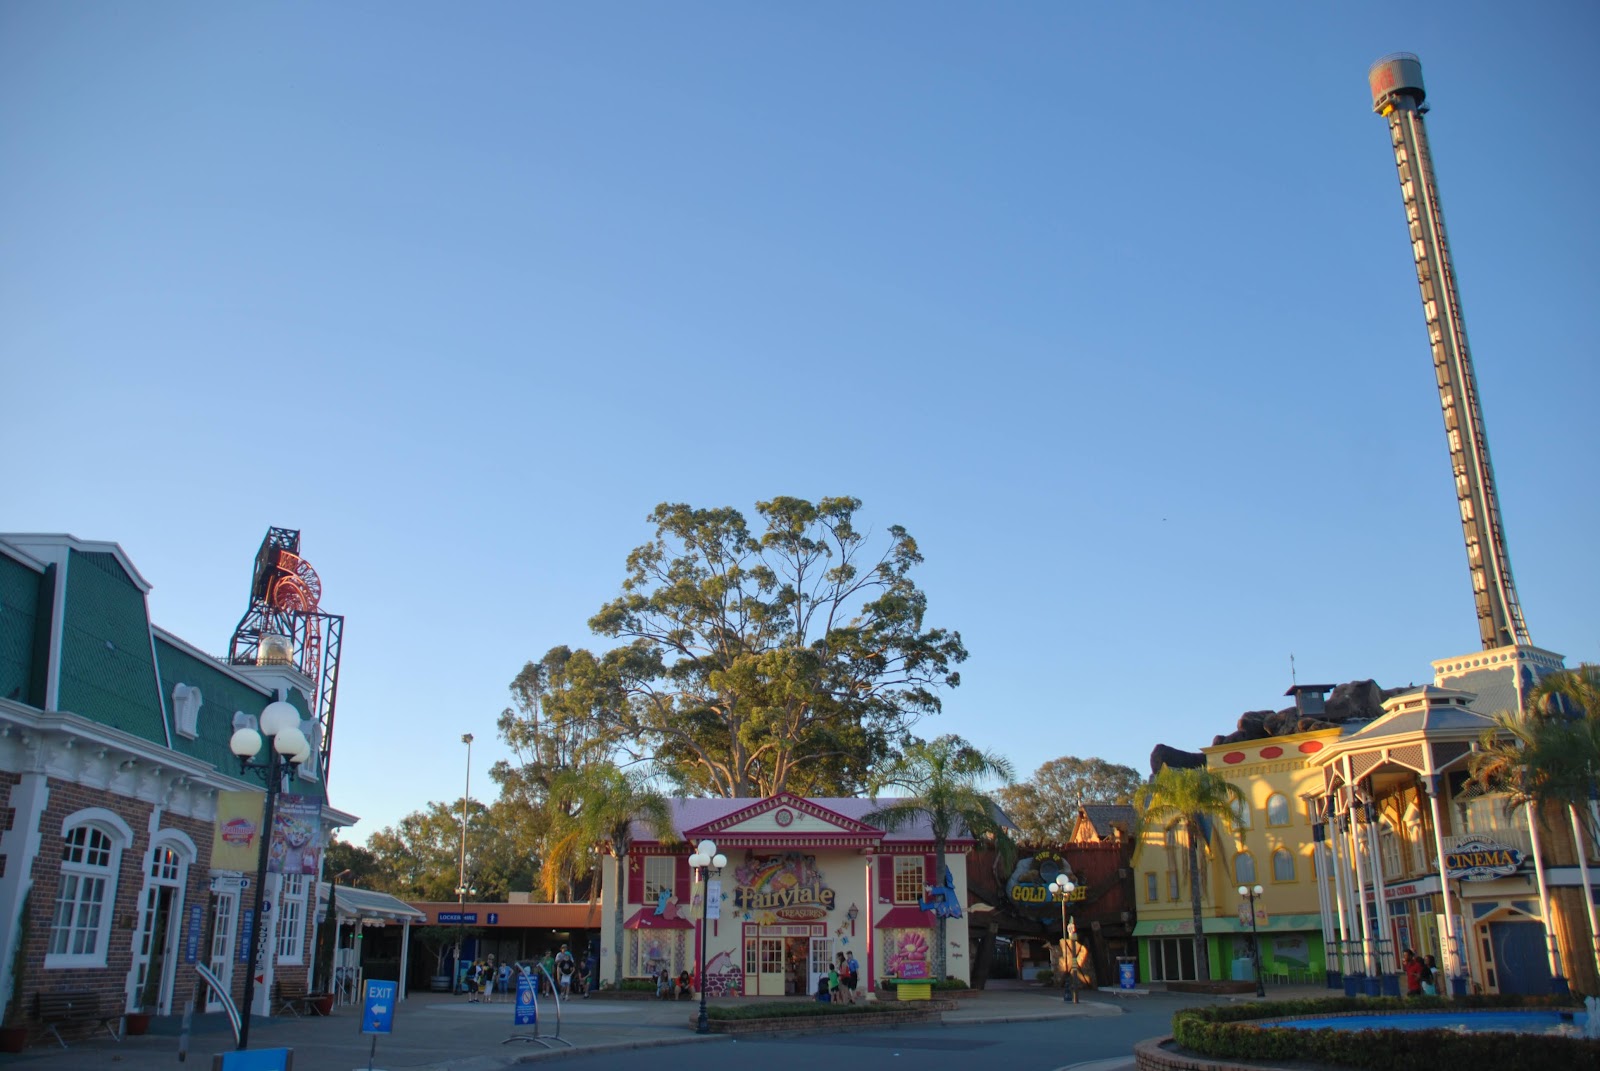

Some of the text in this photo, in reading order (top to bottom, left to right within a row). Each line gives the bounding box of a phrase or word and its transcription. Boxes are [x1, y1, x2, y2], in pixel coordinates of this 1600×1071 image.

[1445, 849, 1514, 870] CINEMA
[738, 882, 833, 912] Fairytale
[1012, 885, 1088, 902] GOLD RSH
[781, 908, 825, 918] TREASURES
[369, 986, 392, 999] EXIT
